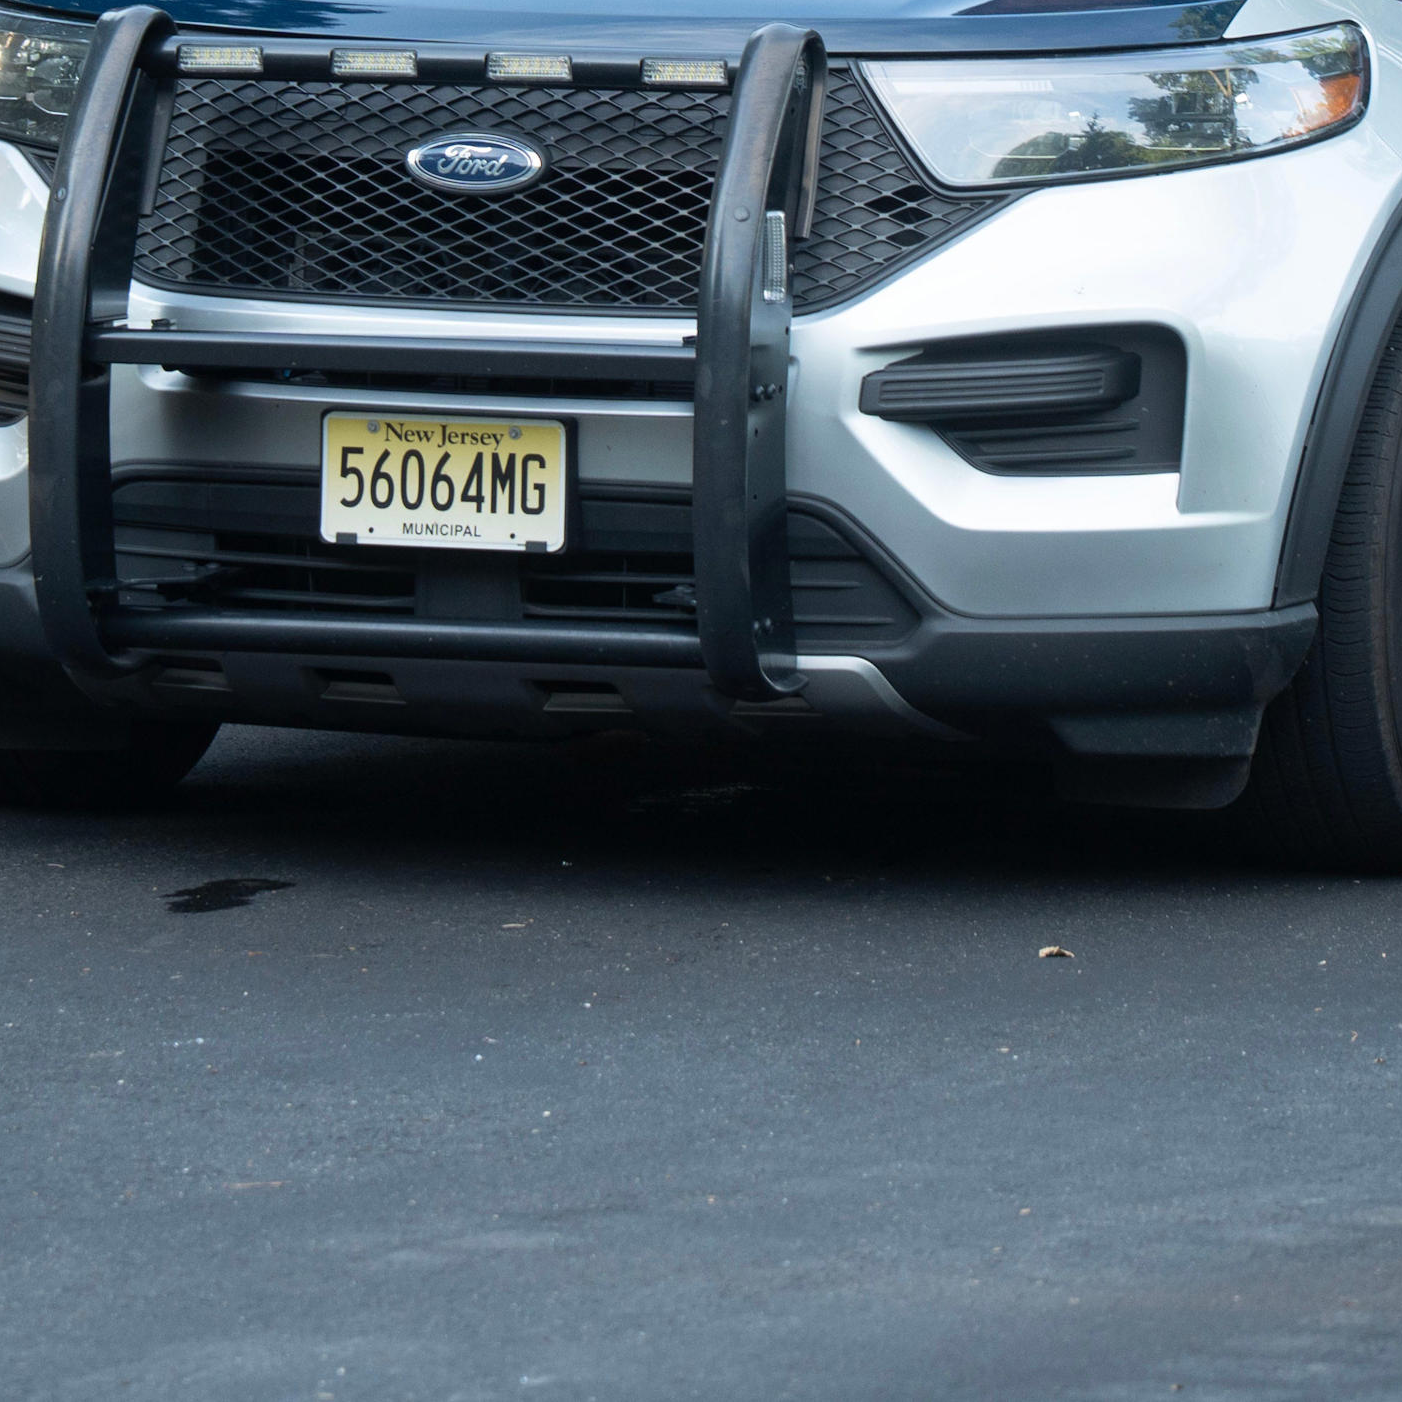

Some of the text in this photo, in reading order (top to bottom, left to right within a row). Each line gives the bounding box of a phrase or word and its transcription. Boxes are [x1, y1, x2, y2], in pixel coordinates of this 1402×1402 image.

[437, 143, 509, 177] Ford
[384, 422, 505, 451] New Jersey
[340, 446, 546, 516] 56064MG
[402, 522, 482, 538] MUNICIPAL
